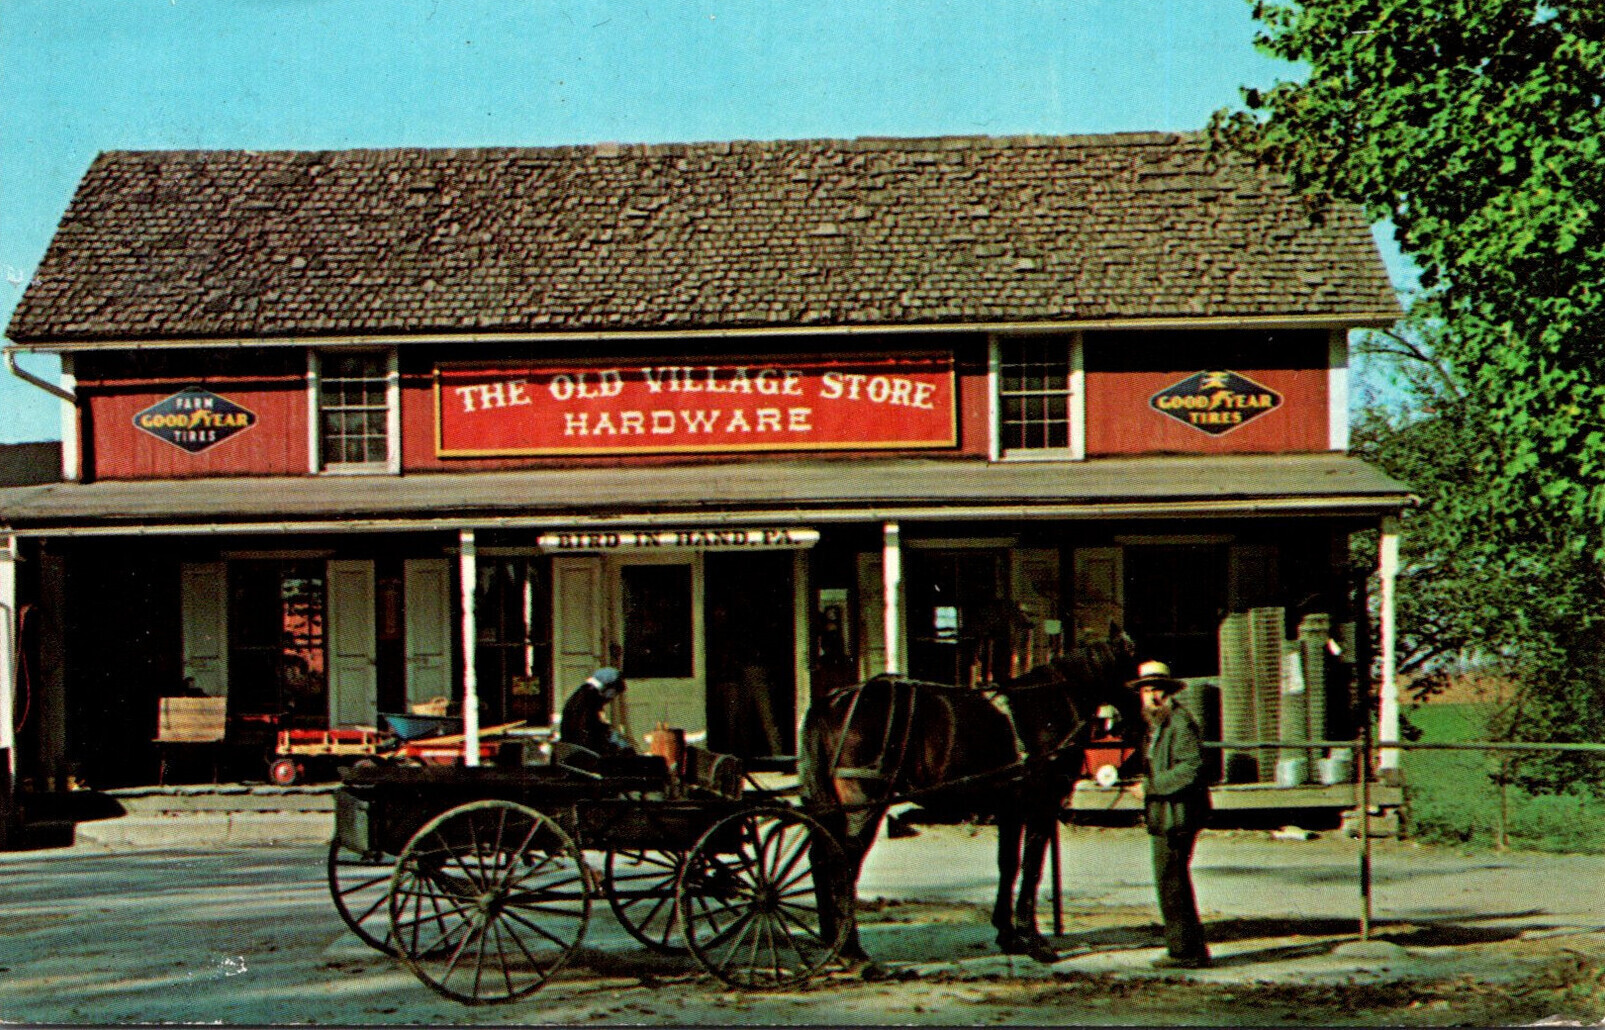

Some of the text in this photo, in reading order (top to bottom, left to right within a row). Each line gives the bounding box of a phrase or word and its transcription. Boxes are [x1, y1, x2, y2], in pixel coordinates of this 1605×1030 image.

[455, 366, 937, 412] THE OLD VILLAGE STORE
[175, 398, 214, 409] FARM
[564, 407, 812, 435] HARDWARE
[1189, 411, 1242, 424] TIRES
[174, 430, 216, 442] TIRES
[559, 533, 620, 548] BIRD
[635, 532, 660, 546] IN
